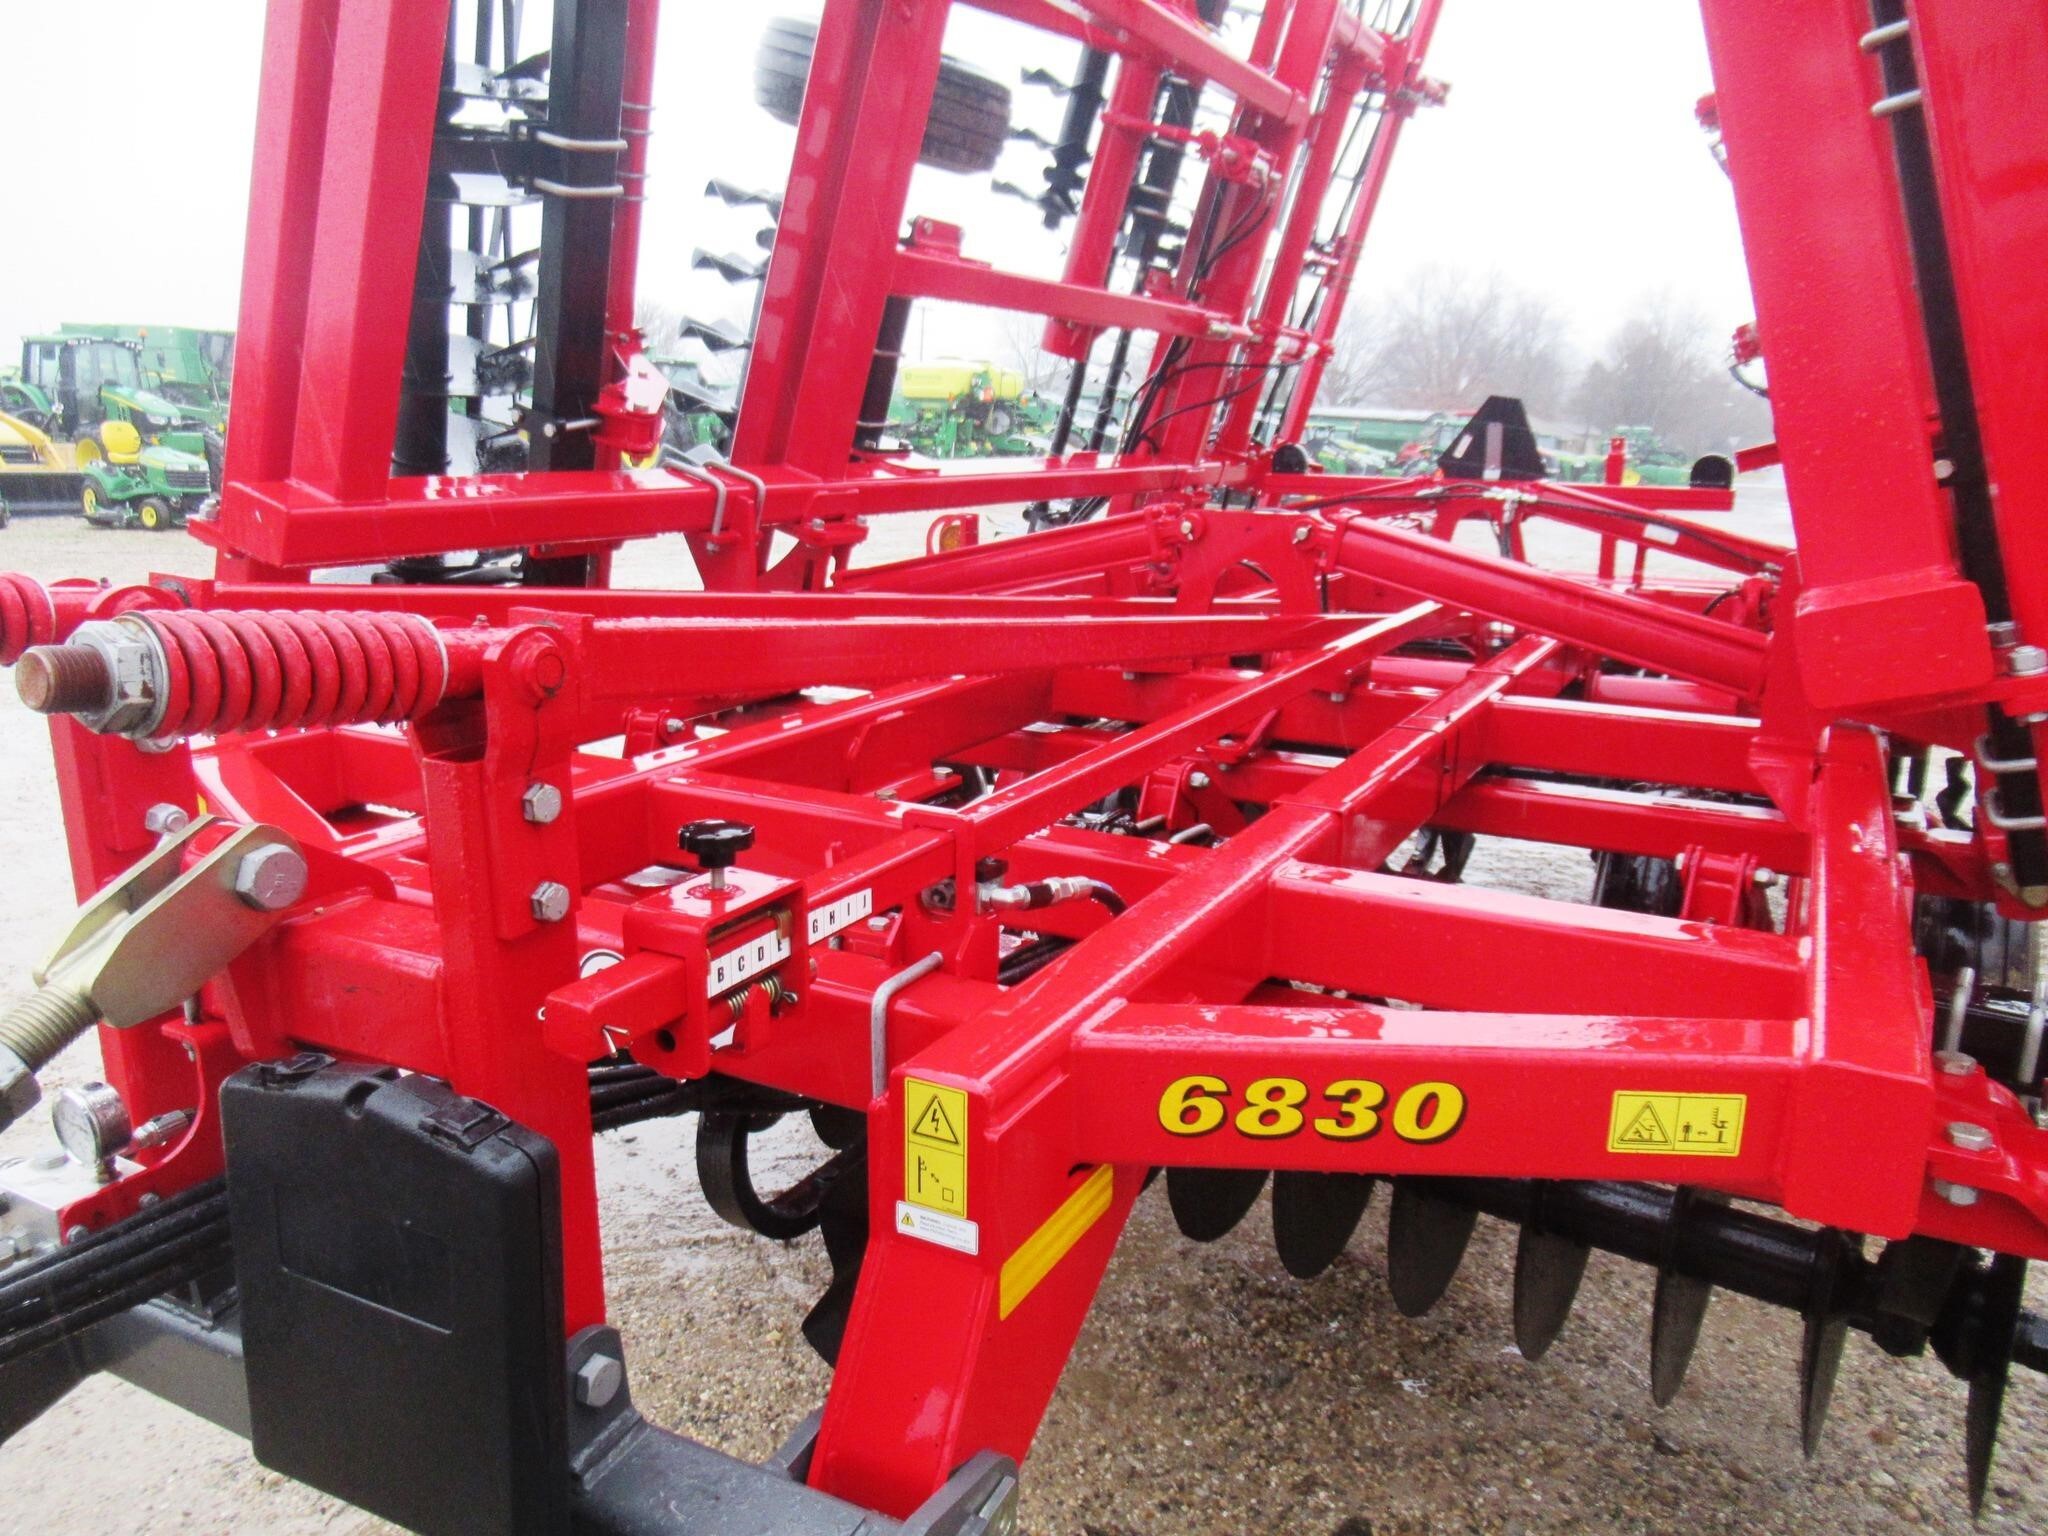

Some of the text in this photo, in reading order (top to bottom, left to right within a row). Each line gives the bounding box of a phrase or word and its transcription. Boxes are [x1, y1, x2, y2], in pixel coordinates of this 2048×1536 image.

[812, 918, 819, 934] G
[829, 910, 836, 926] H
[717, 966, 724, 983] B
[738, 956, 745, 972] C
[758, 946, 765, 962] D
[1158, 1075, 1467, 1145] 6830
